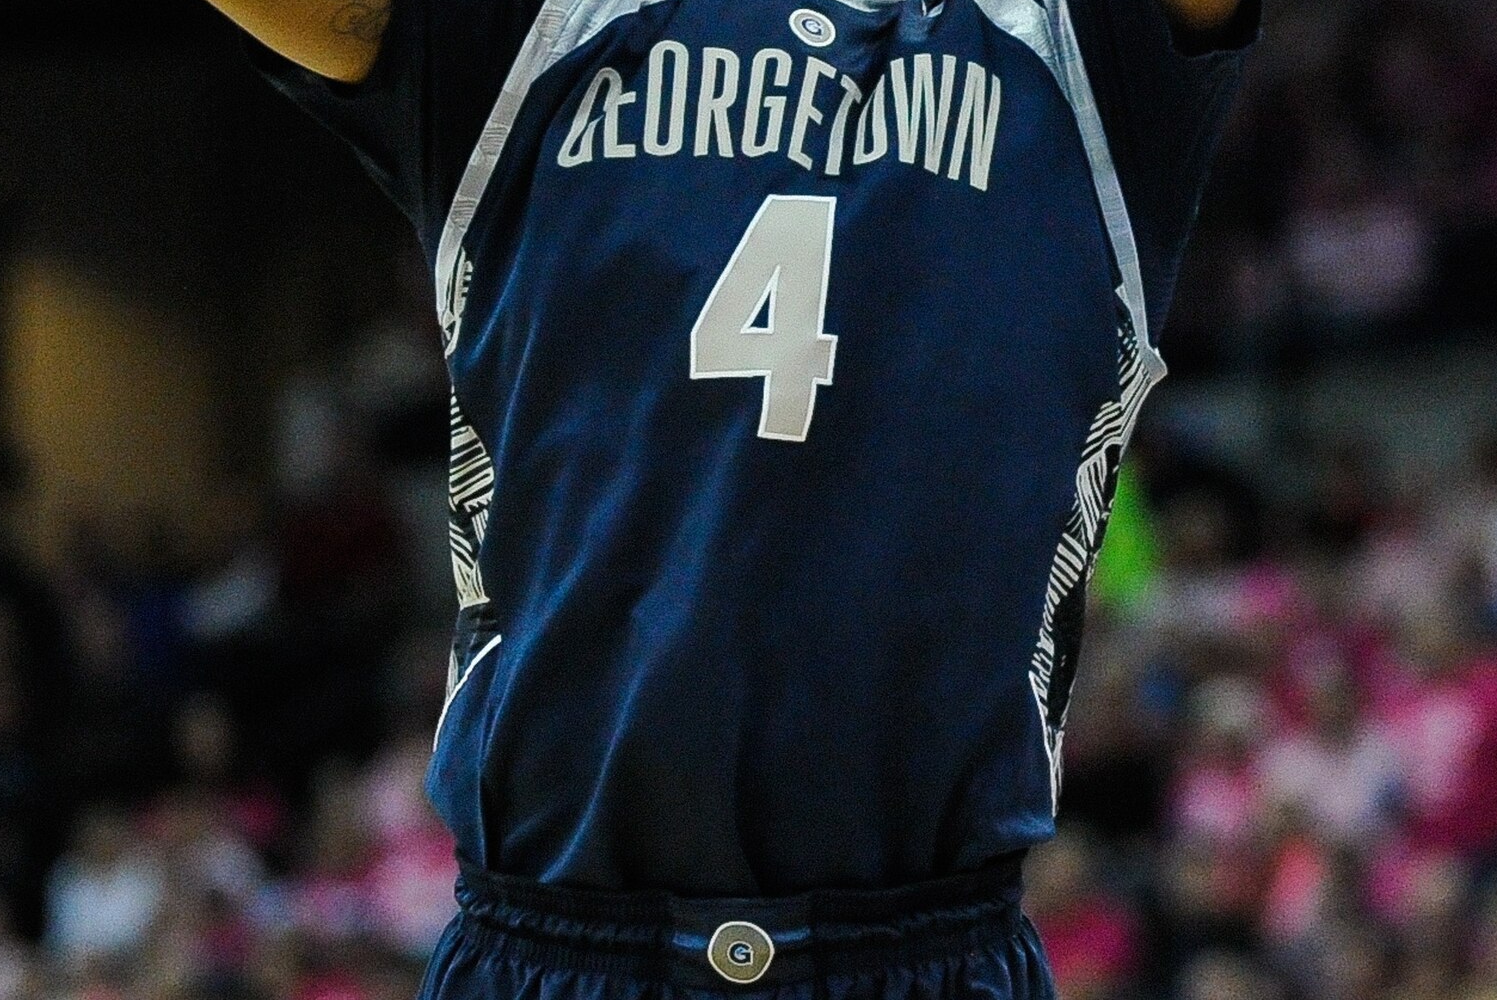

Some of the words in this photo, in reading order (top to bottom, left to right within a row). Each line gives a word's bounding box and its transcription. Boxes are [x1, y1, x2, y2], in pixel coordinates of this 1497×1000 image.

[557, 40, 1001, 192] GEORGETOWN
[689, 195, 838, 443] 4
[727, 940, 754, 967] G
